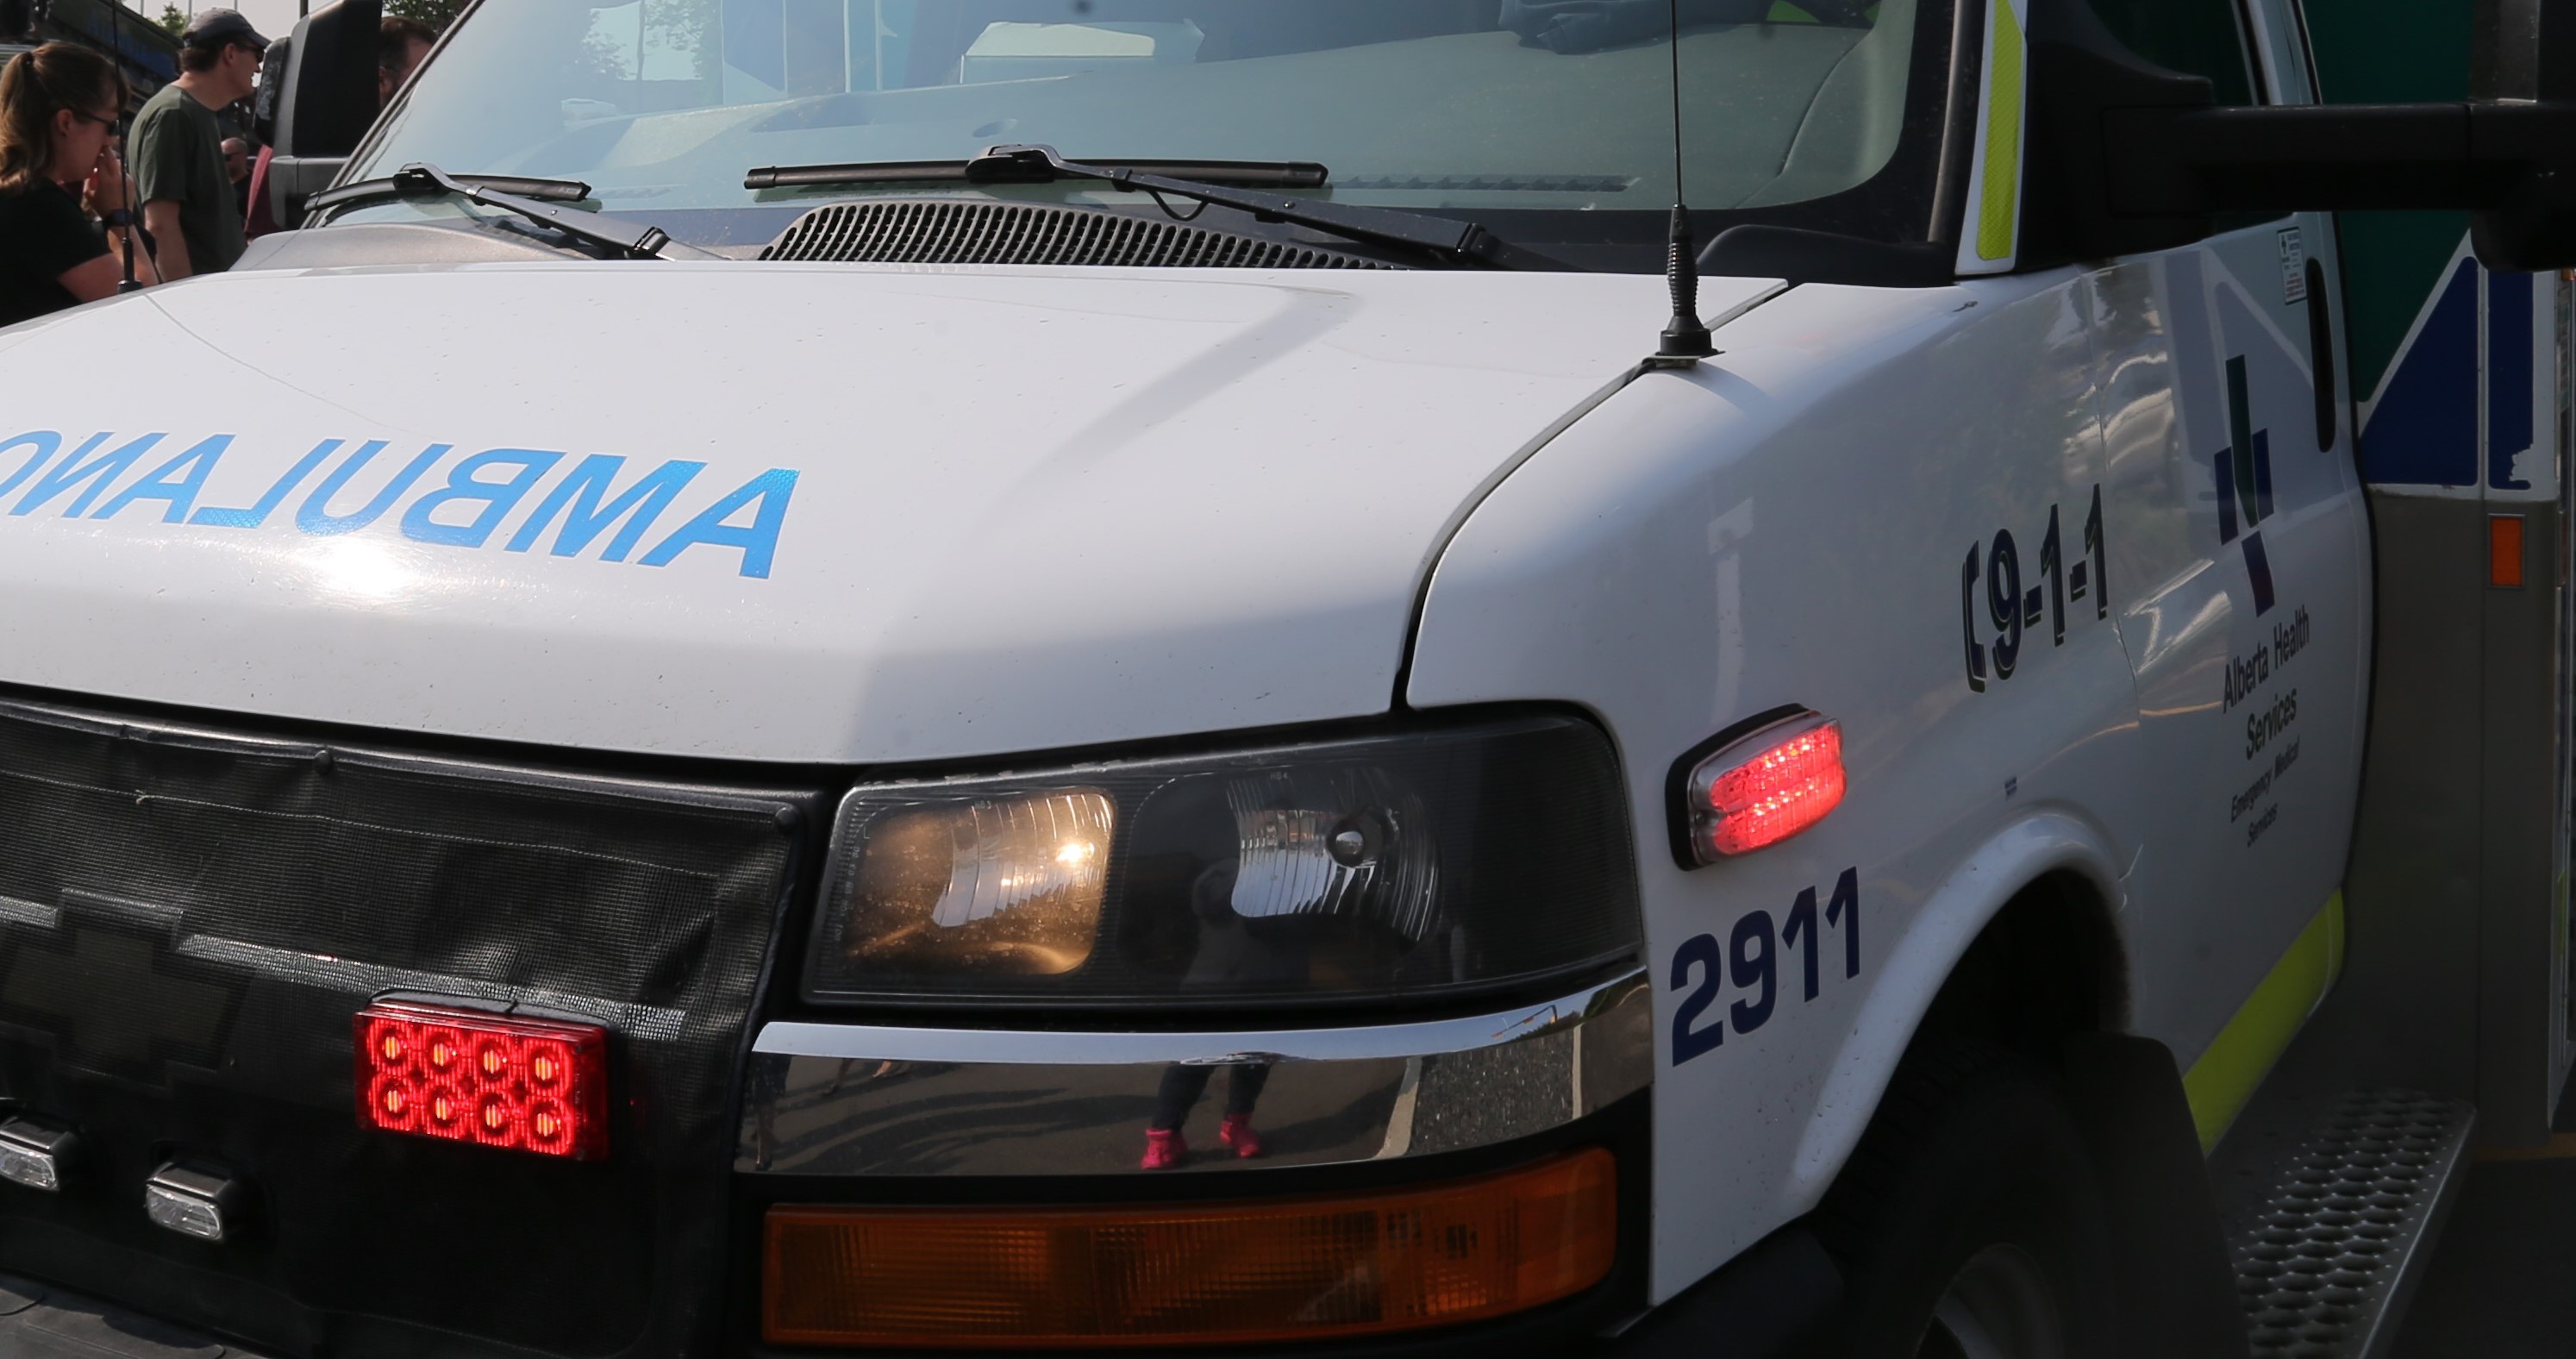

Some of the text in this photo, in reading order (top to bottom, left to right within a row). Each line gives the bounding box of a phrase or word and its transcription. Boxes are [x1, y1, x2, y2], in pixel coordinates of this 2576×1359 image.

[1987, 483, 2109, 680] 9-1-1
[2223, 604, 2310, 715] Alberta Health
[2246, 688, 2297, 761] Services
[2230, 766, 2273, 824] Emergency
[1670, 865, 1860, 1068] 2911
